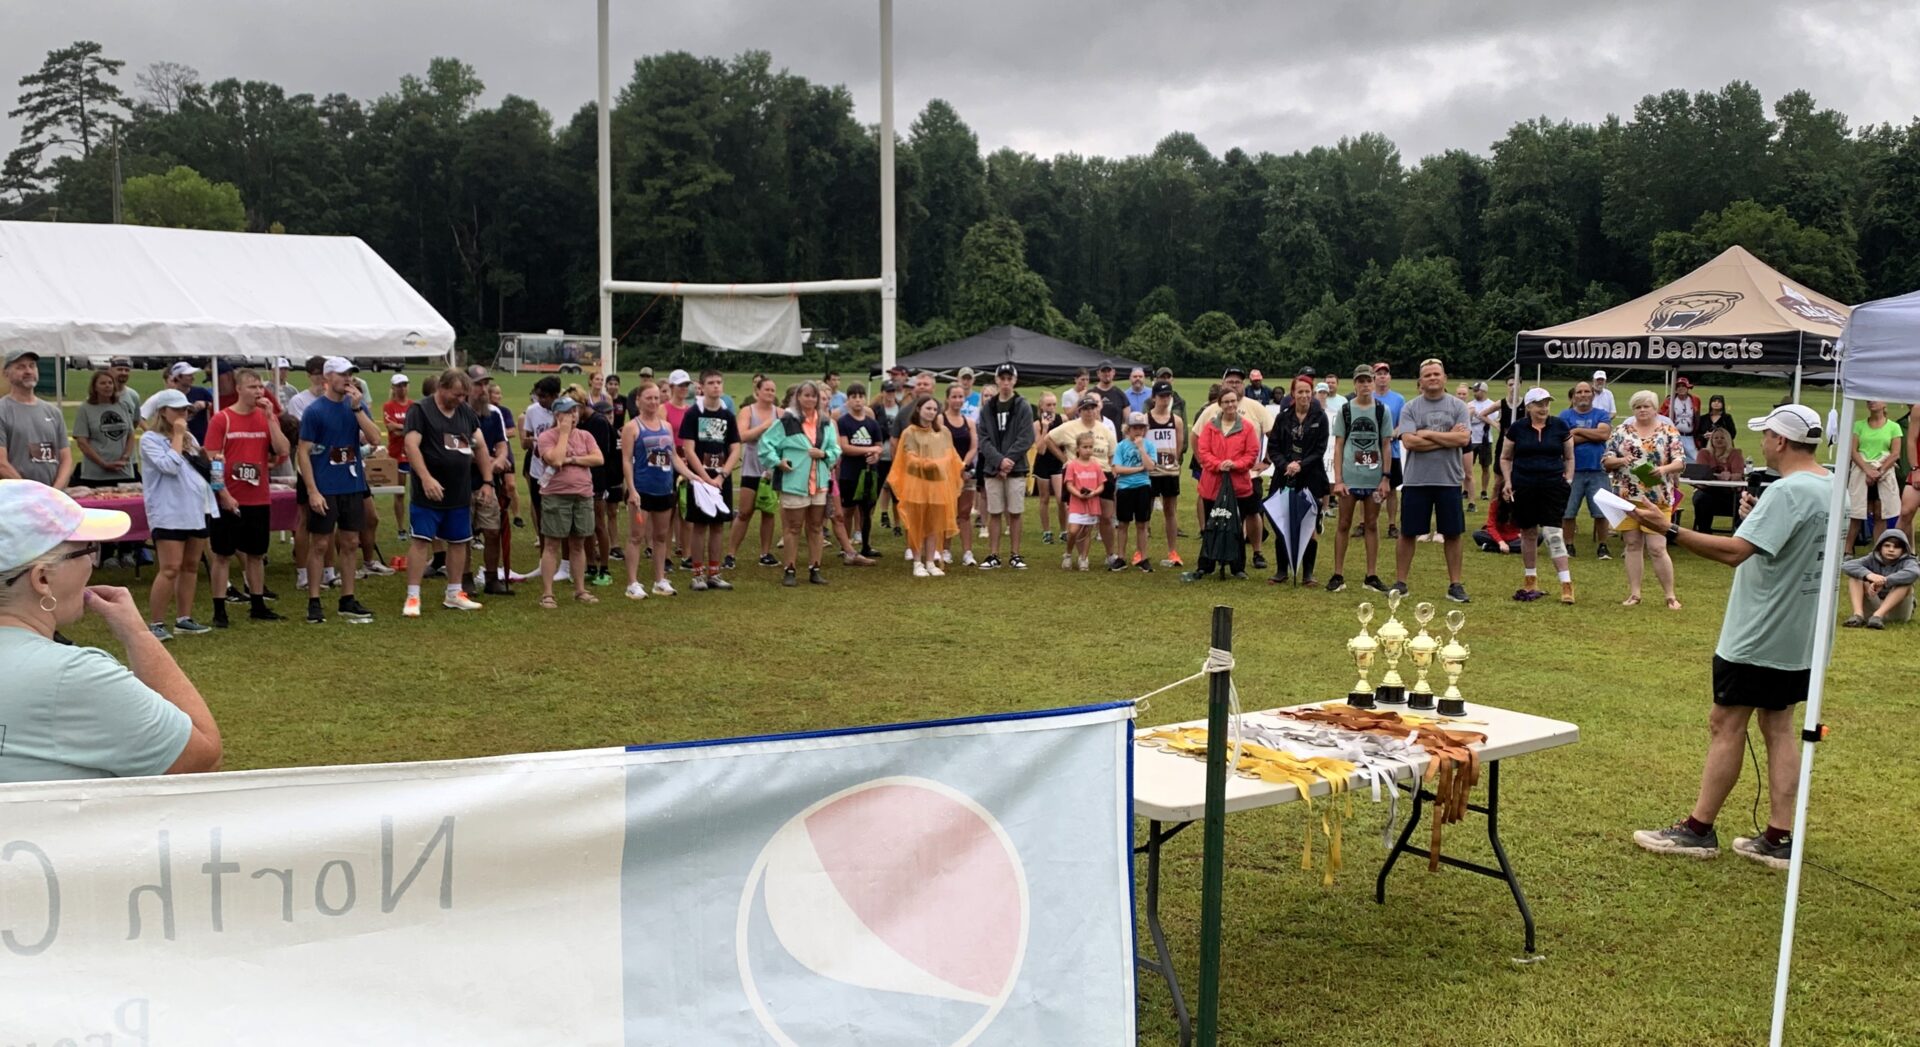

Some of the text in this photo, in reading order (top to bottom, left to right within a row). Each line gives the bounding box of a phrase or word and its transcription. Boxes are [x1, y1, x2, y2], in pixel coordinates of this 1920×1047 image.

[1544, 336, 1763, 360] Cullman Bearcats
[1154, 431, 1171, 440] CATS
[40, 447, 52, 460] 23
[1362, 454, 1372, 464] 36
[238, 467, 256, 480] 180
